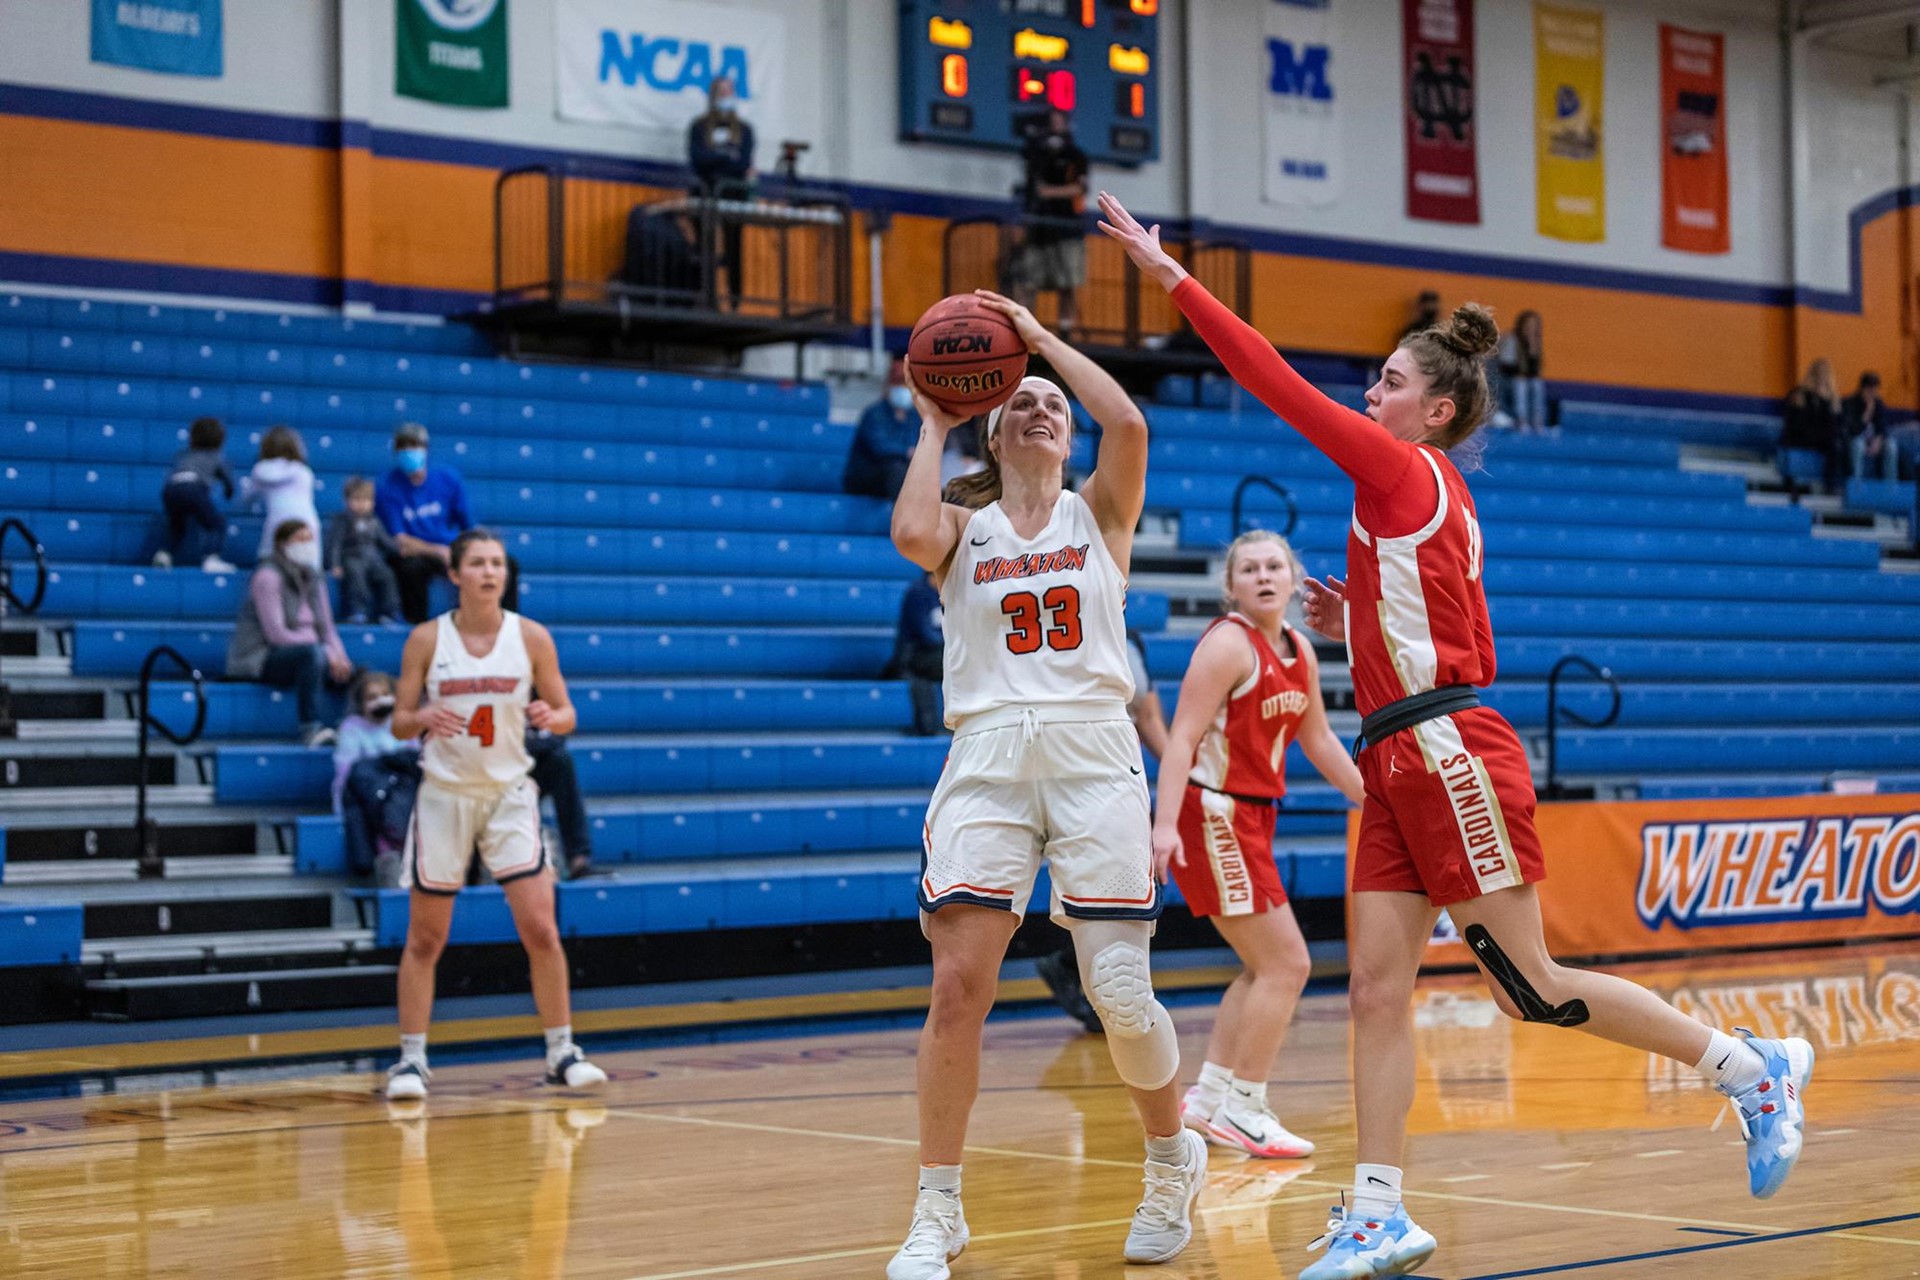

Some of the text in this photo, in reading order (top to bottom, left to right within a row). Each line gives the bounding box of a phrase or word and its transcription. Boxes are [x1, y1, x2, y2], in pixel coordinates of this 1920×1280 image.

[600, 29, 750, 99] NCAA
[1267, 37, 1334, 101] M
[933, 335, 993, 355] NCAA
[925, 368, 1003, 394] Wilson
[974, 544, 1090, 585] WHEATON
[1001, 584, 1083, 655] 33
[468, 704, 495, 747] 4
[1440, 752, 1507, 878] CARDINALS
[1211, 814, 1249, 904] CARDINALS
[1635, 812, 1920, 931] WHEATO
[1476, 939, 1487, 950] KT
[247, 981, 261, 1007] A
